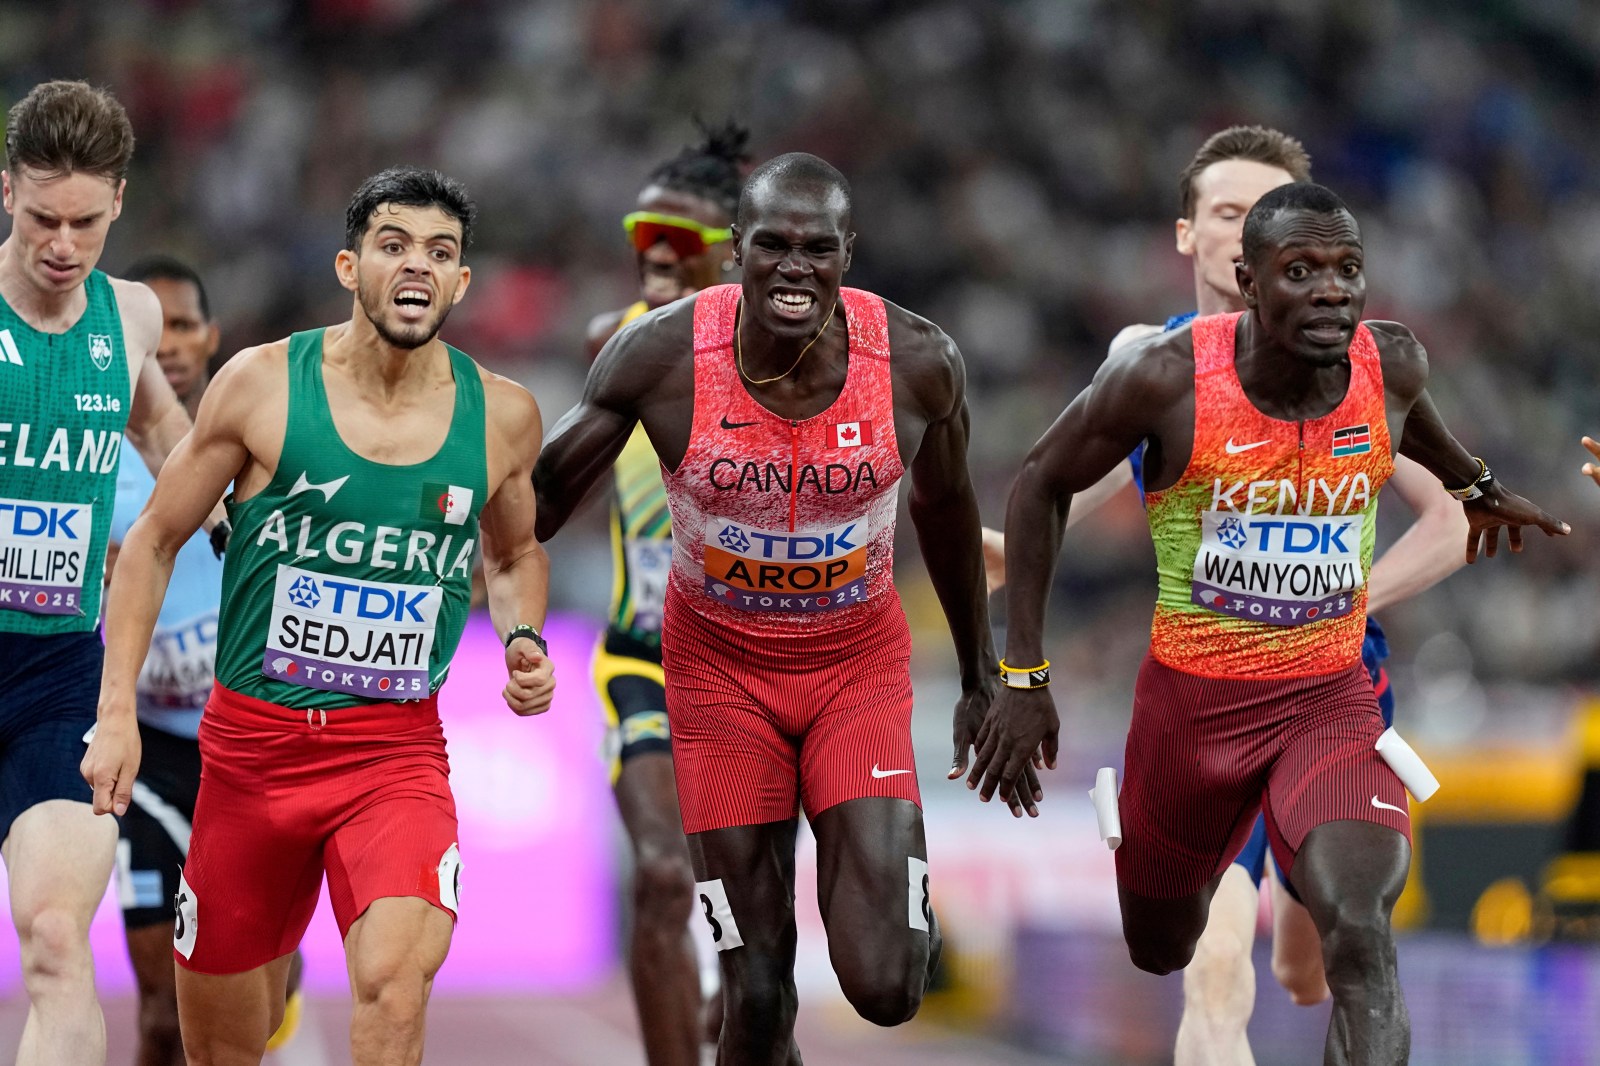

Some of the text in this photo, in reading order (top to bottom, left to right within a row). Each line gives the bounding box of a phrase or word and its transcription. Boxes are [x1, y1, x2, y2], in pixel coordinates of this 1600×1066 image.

[74, 394, 121, 412] 123.ie
[709, 458, 878, 494] CANADA
[1210, 472, 1371, 517] KENYA
[256, 509, 475, 578] ALGERIA
[750, 523, 857, 560] TDK
[1249, 521, 1352, 555] TDK
[724, 559, 849, 590] AROP
[1204, 551, 1356, 596] WANYONYI
[322, 580, 429, 622] TDK
[278, 614, 425, 666] SEDJATI
